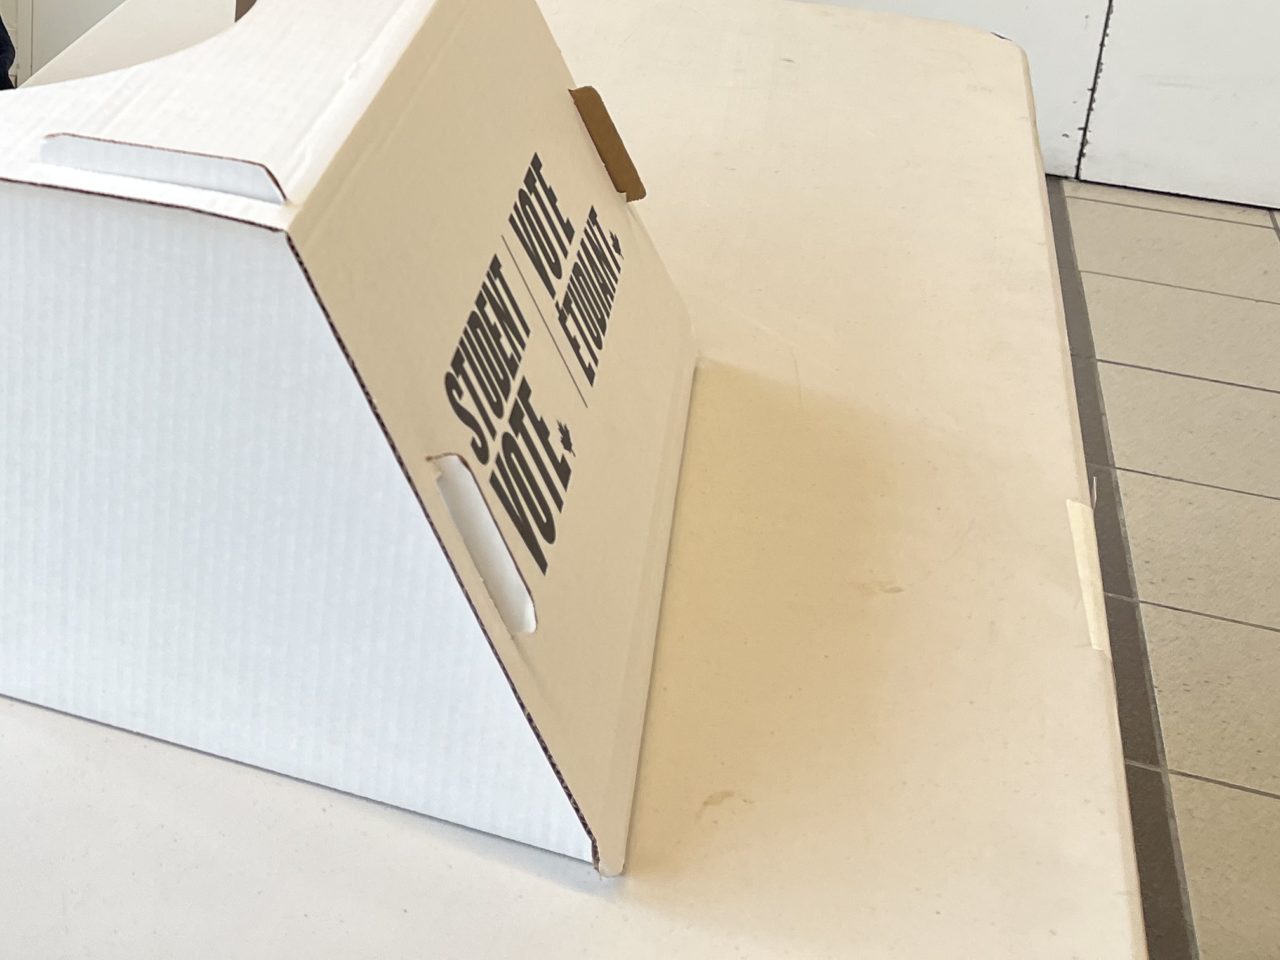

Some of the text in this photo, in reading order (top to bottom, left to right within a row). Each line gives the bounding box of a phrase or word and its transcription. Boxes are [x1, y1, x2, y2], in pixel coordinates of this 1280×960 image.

[508, 152, 575, 299] VOTE
[556, 206, 621, 387] ÉTUDIANT
[444, 254, 530, 465] STUDENT
[489, 376, 572, 576] VOTE
